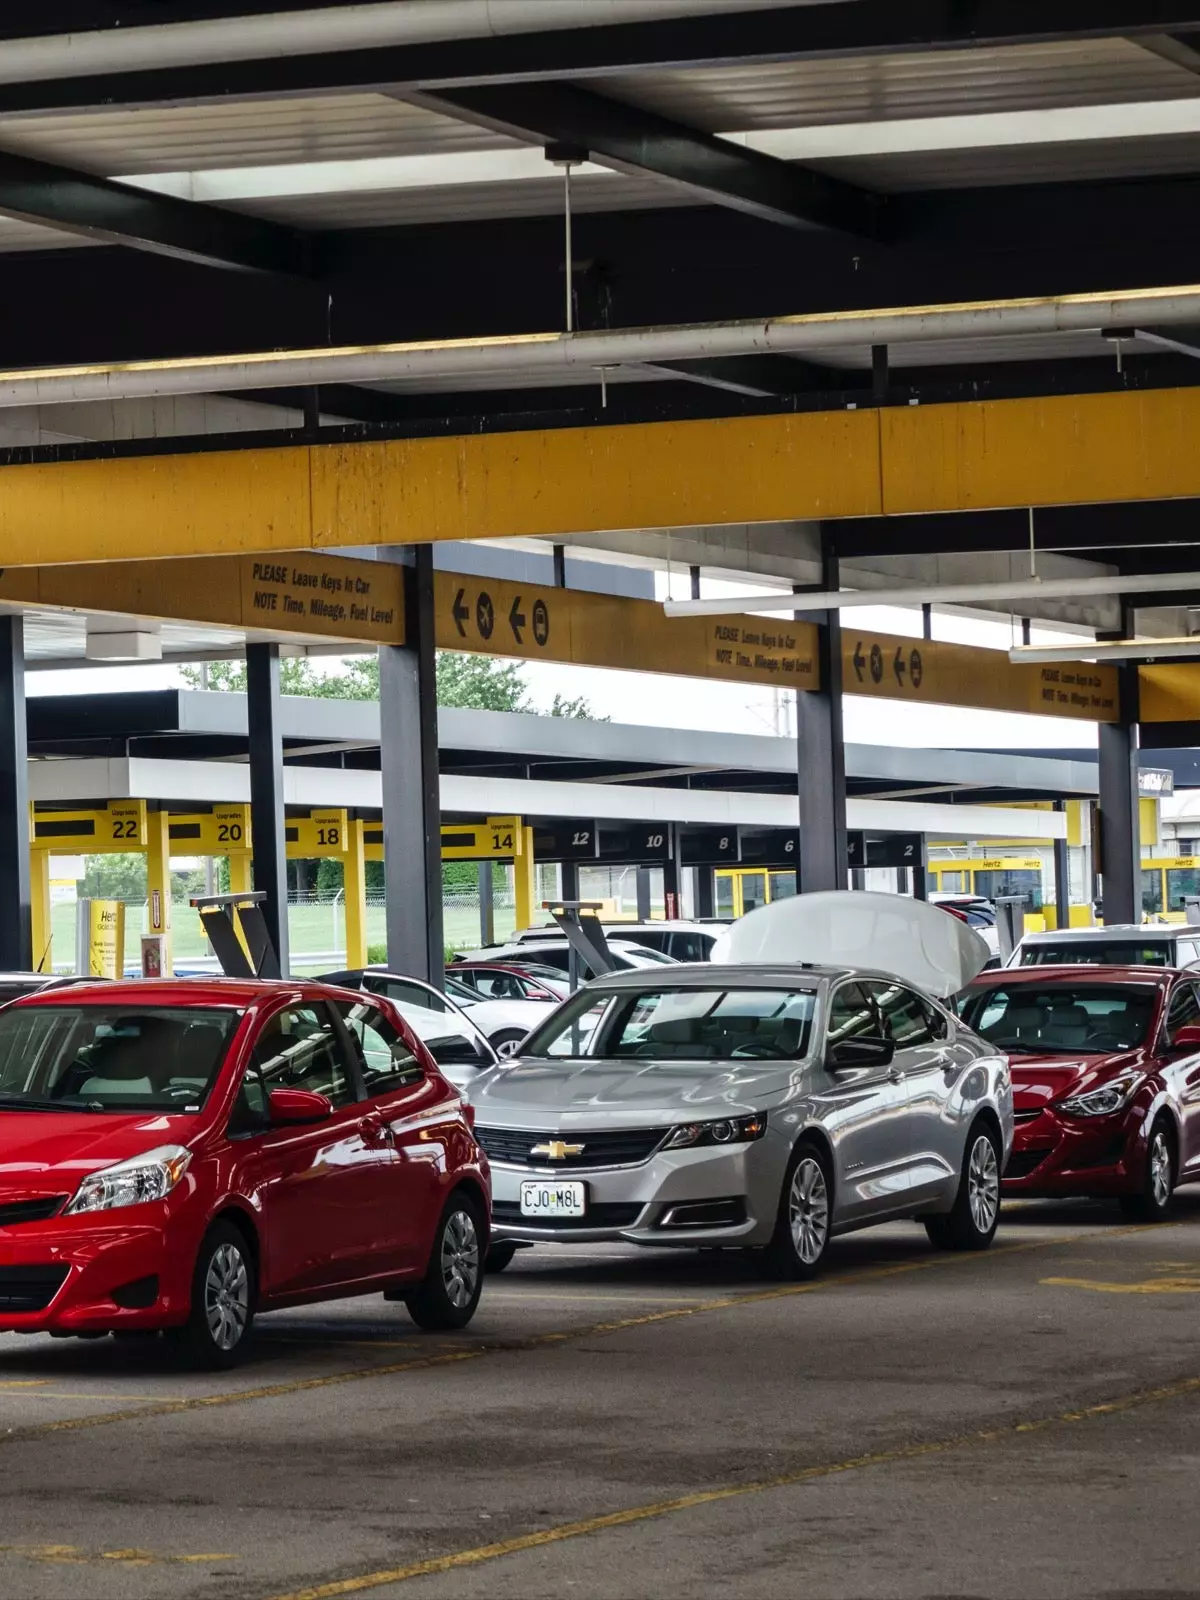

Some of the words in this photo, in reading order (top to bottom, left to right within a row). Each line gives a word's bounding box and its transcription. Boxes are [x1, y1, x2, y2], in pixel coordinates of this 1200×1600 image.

[253, 563, 288, 584] PLEASE
[292, 569, 318, 588] Leave
[321, 573, 342, 594] Keys
[344, 576, 353, 593] In
[355, 578, 371, 594] Car
[254, 591, 278, 610] NOTE
[283, 594, 306, 616] Time,
[310, 598, 346, 621] Mileage,
[350, 603, 368, 621] Fuel
[370, 606, 394, 624] Level
[714, 625, 739, 642] PLEASE
[111, 809, 138, 817] Upgrades
[216, 812, 242, 820] Upgrades
[112, 821, 138, 838] 22
[218, 824, 242, 841] 20
[317, 829, 339, 845] 18
[492, 834, 513, 849] 14
[572, 832, 590, 845] 12
[646, 835, 663, 848] 10
[719, 837, 729, 850] 8
[784, 840, 794, 852] 6
[847, 842, 856, 854] 4
[904, 845, 913, 856] 2
[982, 860, 1001, 868] Hertz
